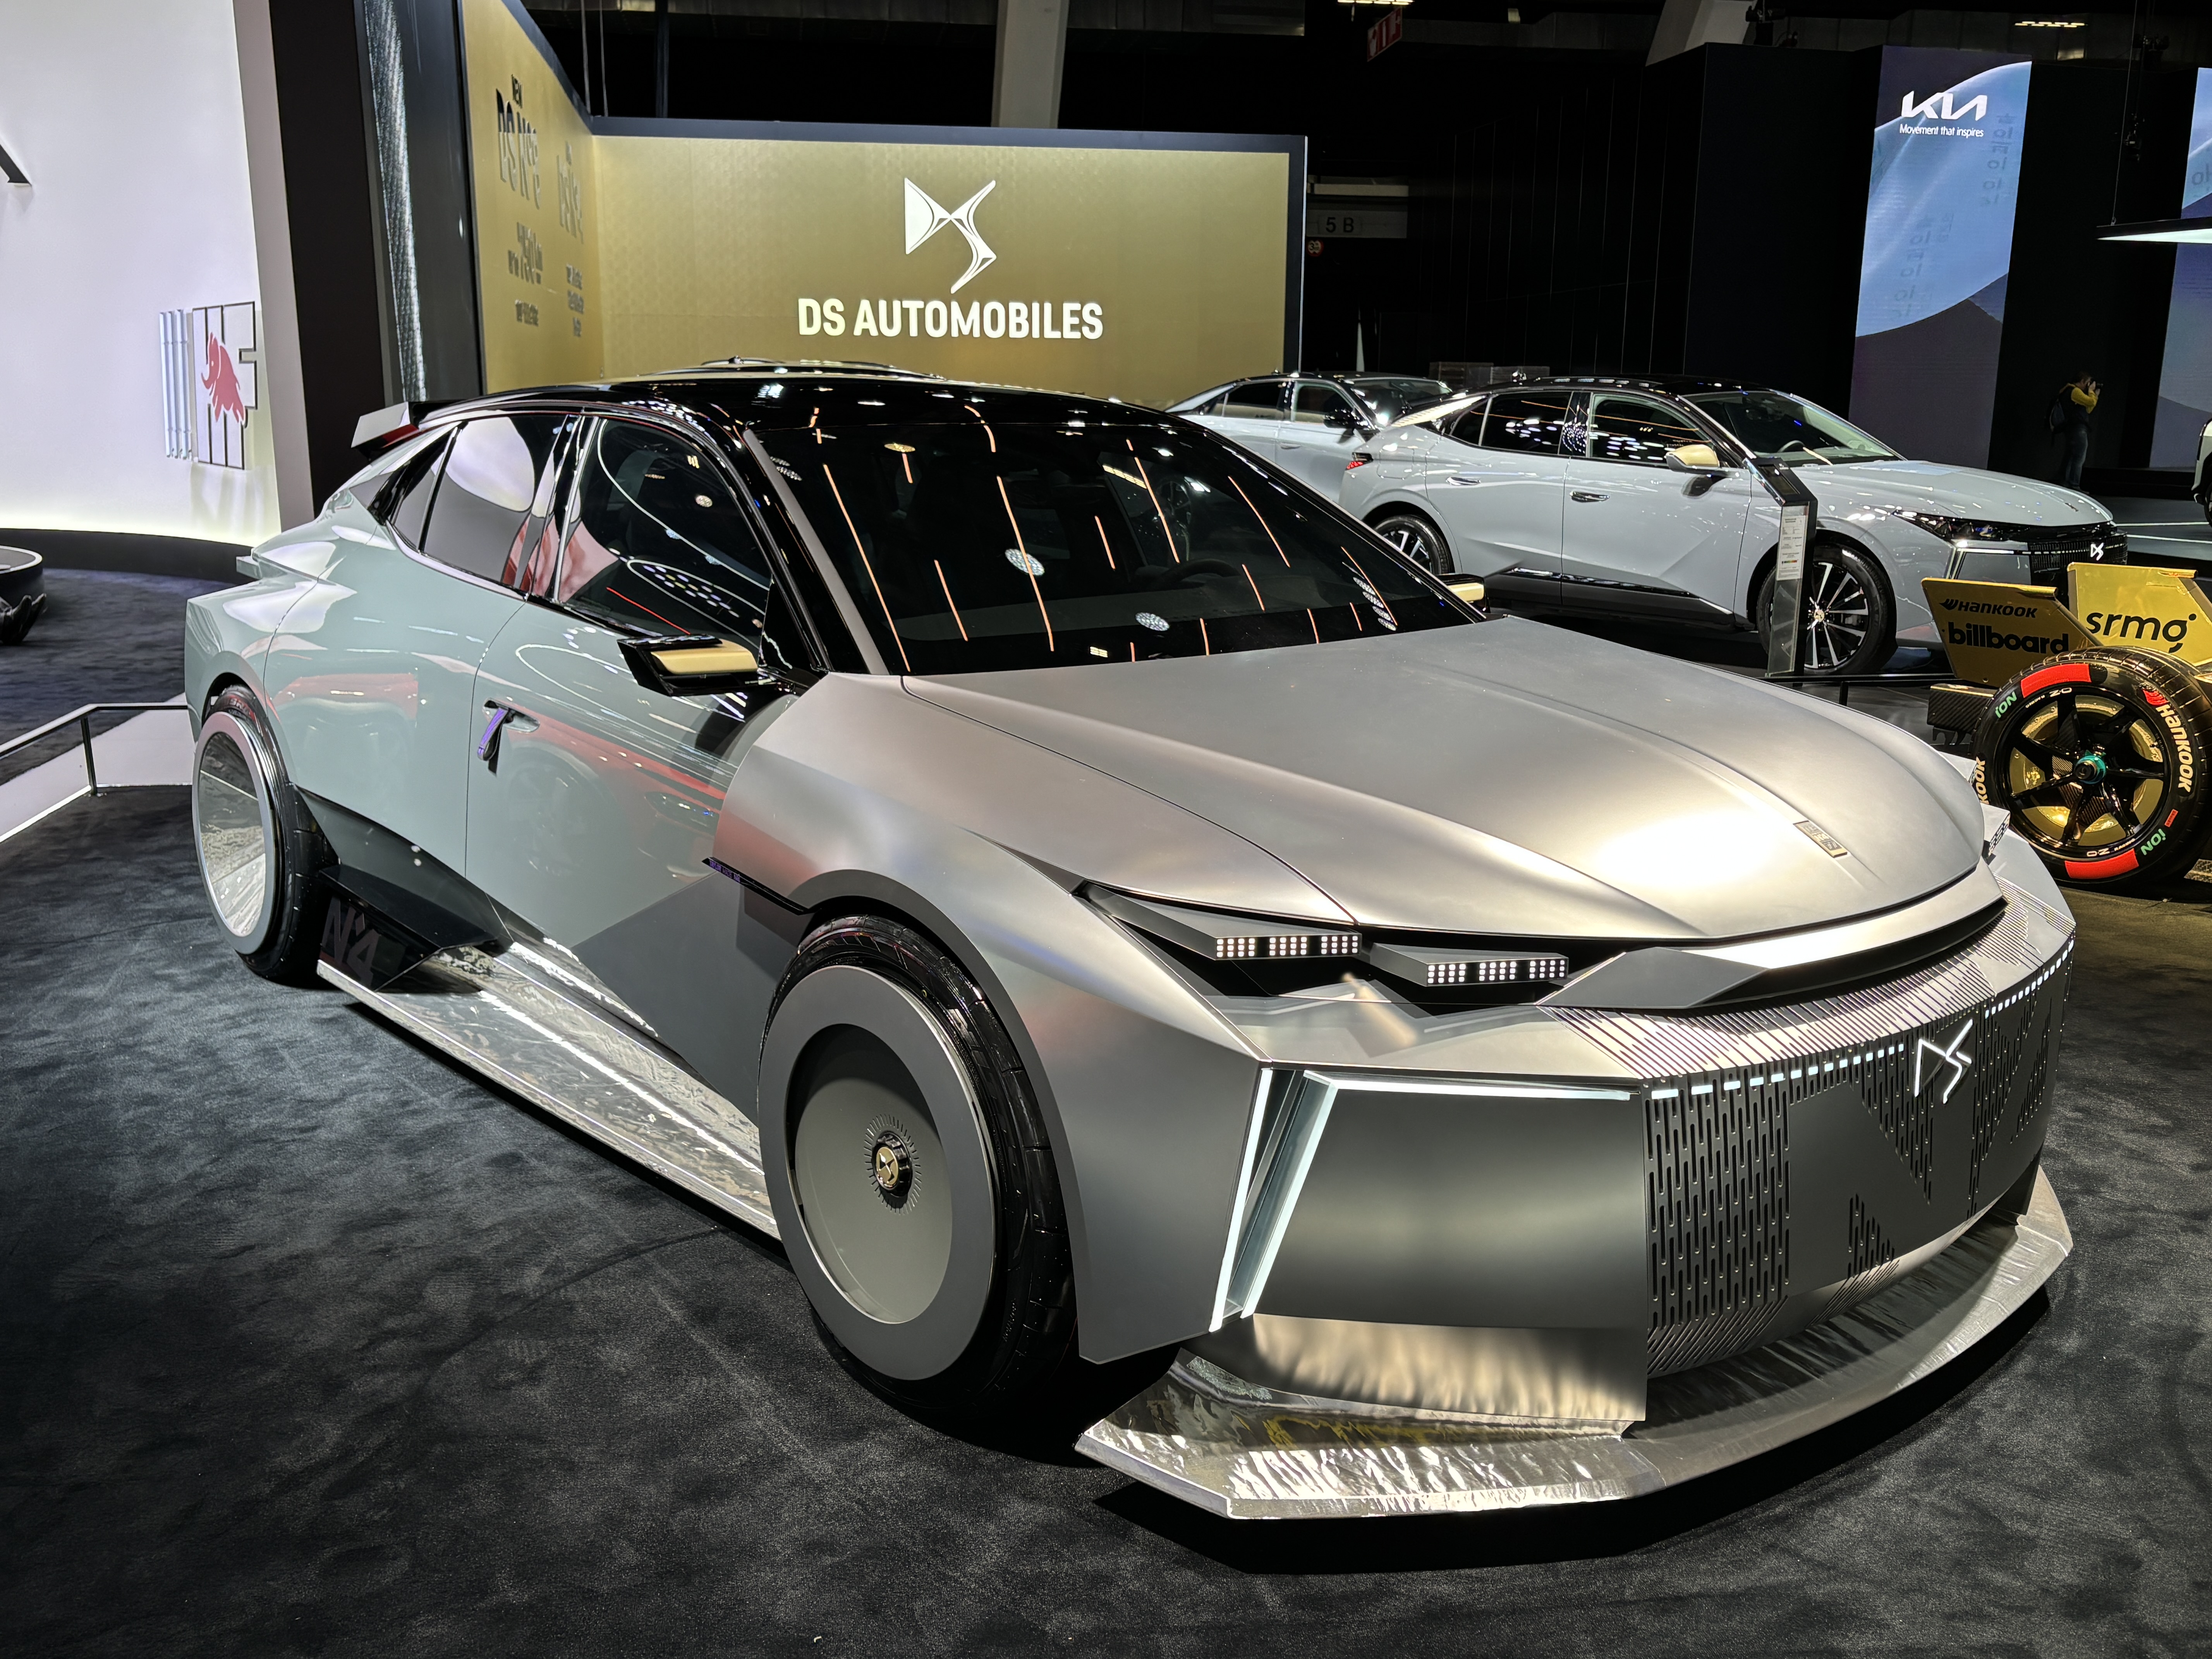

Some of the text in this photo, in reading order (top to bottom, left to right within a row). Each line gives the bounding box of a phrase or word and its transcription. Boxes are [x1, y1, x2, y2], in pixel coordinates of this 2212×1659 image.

[1899, 124, 1984, 138] Movement that inspires
[1326, 217, 1354, 233] 5 B
[798, 298, 1103, 340] DS AUTOMOBILES
[1948, 621, 2069, 655] billboard
[2086, 612, 2197, 653] srmg
